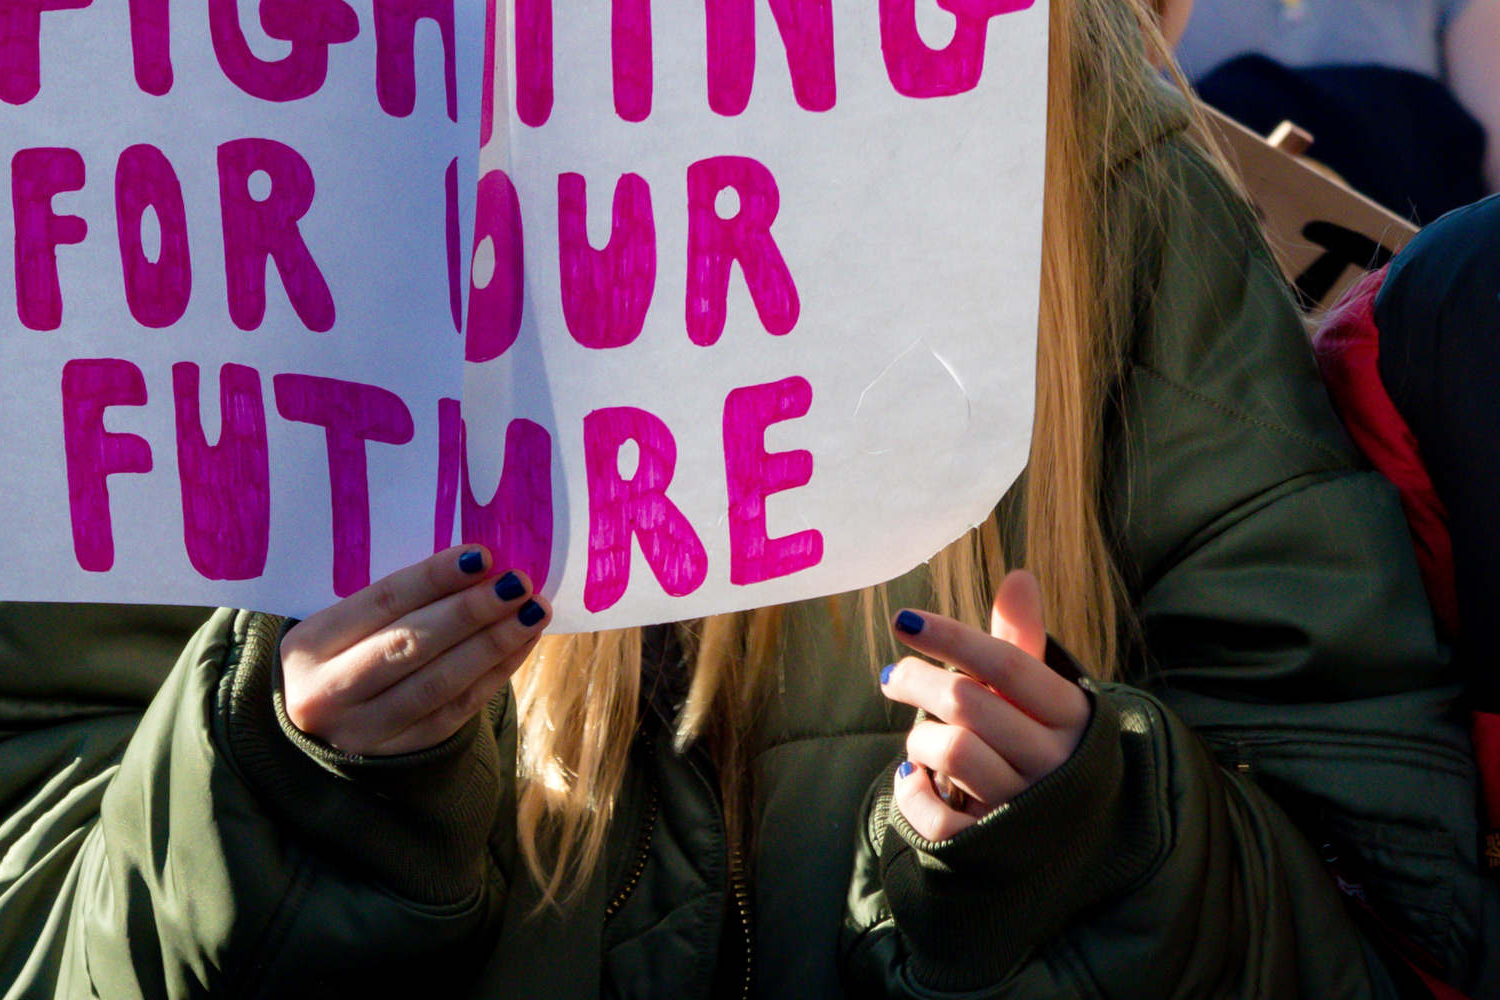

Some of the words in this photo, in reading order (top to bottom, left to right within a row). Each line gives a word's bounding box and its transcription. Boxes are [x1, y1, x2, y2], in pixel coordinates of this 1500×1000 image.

[11, 137, 336, 332] FOR
[445, 154, 800, 363] OUR
[61, 357, 824, 612] FUTURE
